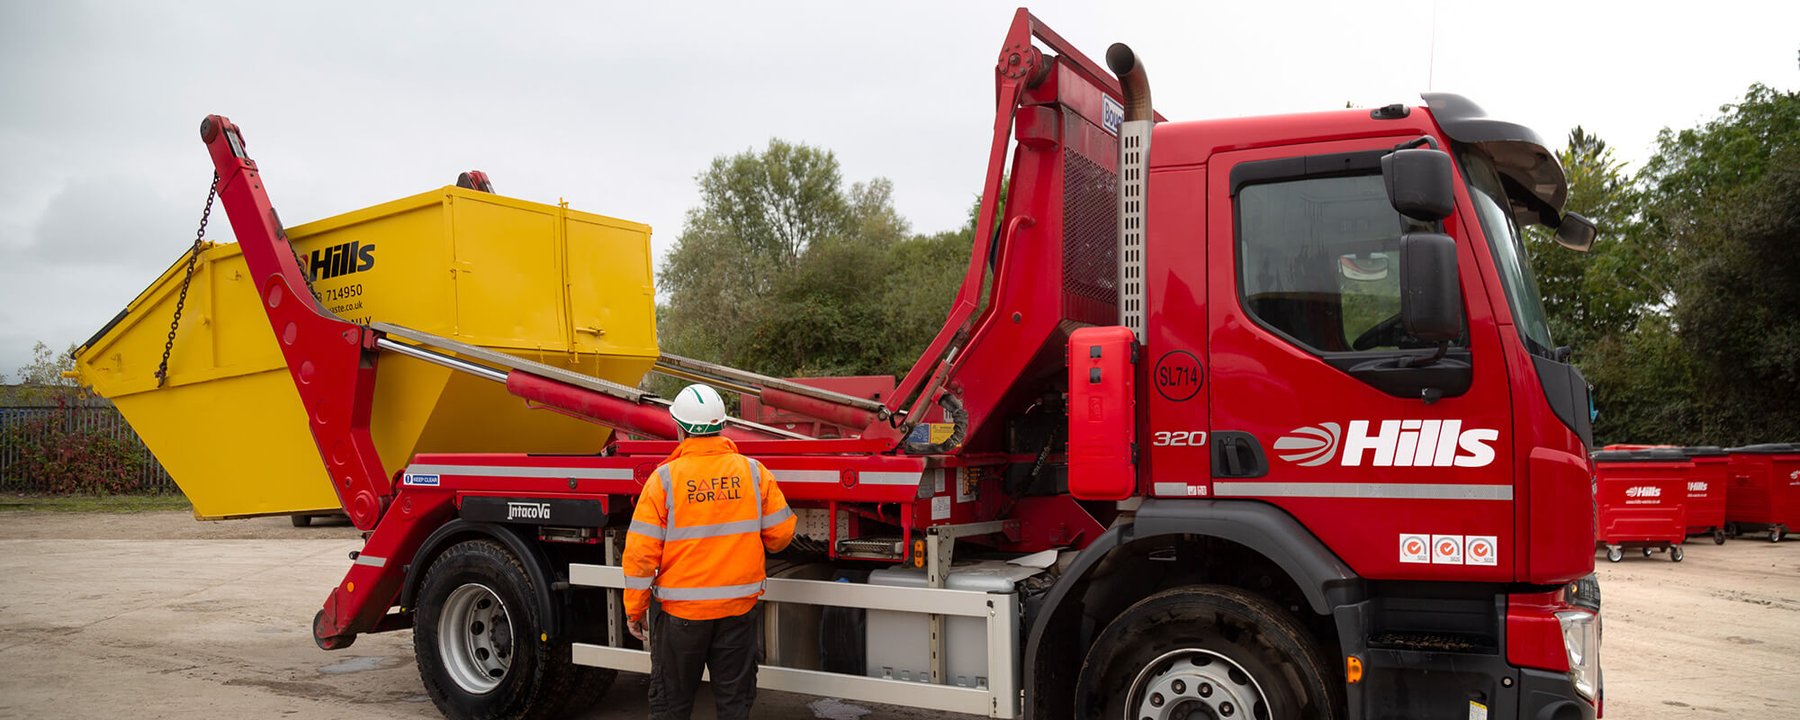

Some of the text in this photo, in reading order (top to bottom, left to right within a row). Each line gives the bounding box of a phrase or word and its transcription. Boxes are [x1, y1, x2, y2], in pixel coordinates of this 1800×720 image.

[310, 240, 375, 282] Hills
[326, 284, 363, 302] 714950
[1160, 366, 1197, 386] SL714
[1153, 431, 1207, 446] 320
[1341, 419, 1499, 467] Hills
[687, 476, 741, 493] SAFER
[1637, 486, 1661, 497] Hills
[507, 502, 550, 519] IntacoVa
